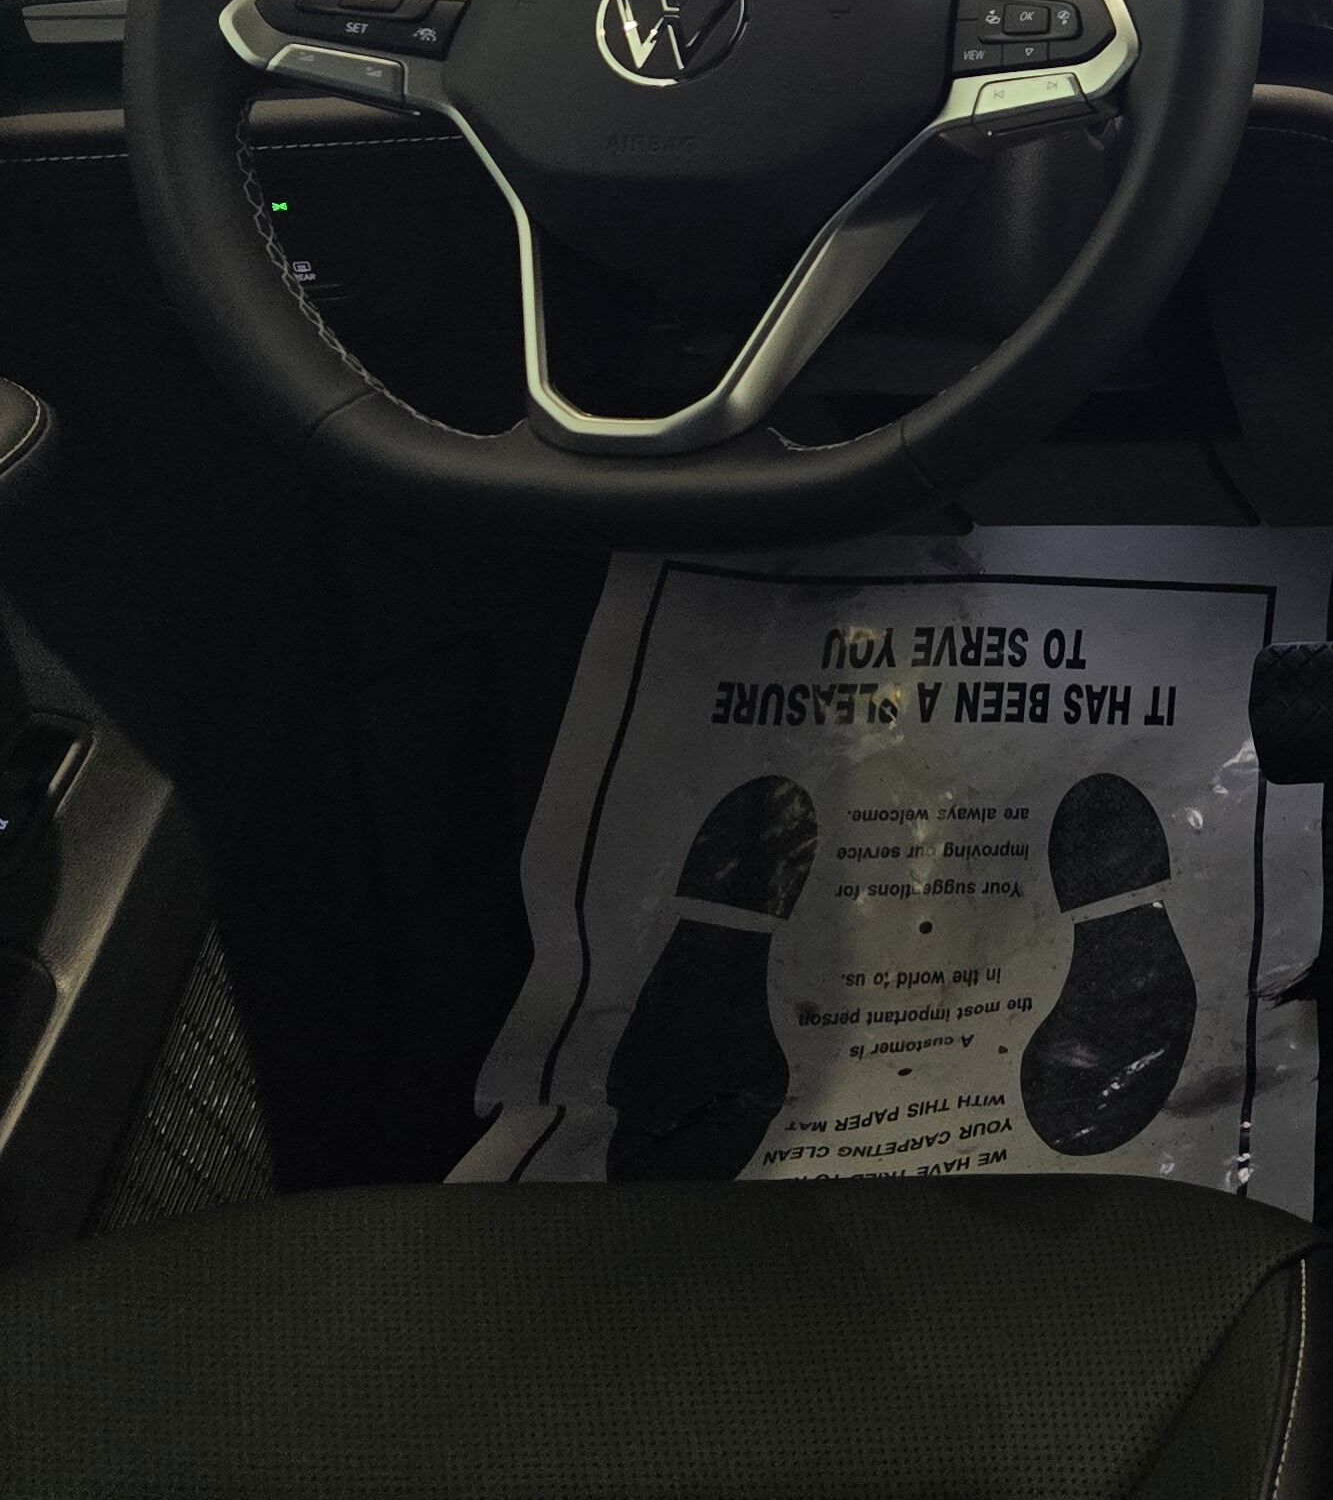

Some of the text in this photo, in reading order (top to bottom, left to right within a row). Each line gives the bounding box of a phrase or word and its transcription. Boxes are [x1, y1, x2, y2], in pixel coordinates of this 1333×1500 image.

[1019, 11, 1034, 21] OK
[345, 22, 369, 34] SET
[963, 50, 986, 60] VIEW
[822, 626, 1086, 670] TO SERVE YOU
[711, 680, 1177, 726] IT HAS BEEN A PLEASURE
[847, 804, 1029, 824] are always welcome.
[836, 846, 900, 862] service
[942, 841, 1029, 860] improving
[835, 883, 860, 900] for
[982, 881, 1021, 897] Your
[841, 972, 865, 987] us.
[897, 971, 945, 988] world
[953, 970, 979, 987] the
[986, 968, 1001, 983] in
[799, 998, 1032, 1027] the most important person
[850, 1034, 974, 1060] A customer is
[785, 1094, 1005, 1133] WITH THIS PAPER MAT
[763, 1118, 1012, 1166] YOUR CARPETING CLEAN
[917, 1156, 970, 1177] HAVE
[978, 1149, 1007, 1167] WE
